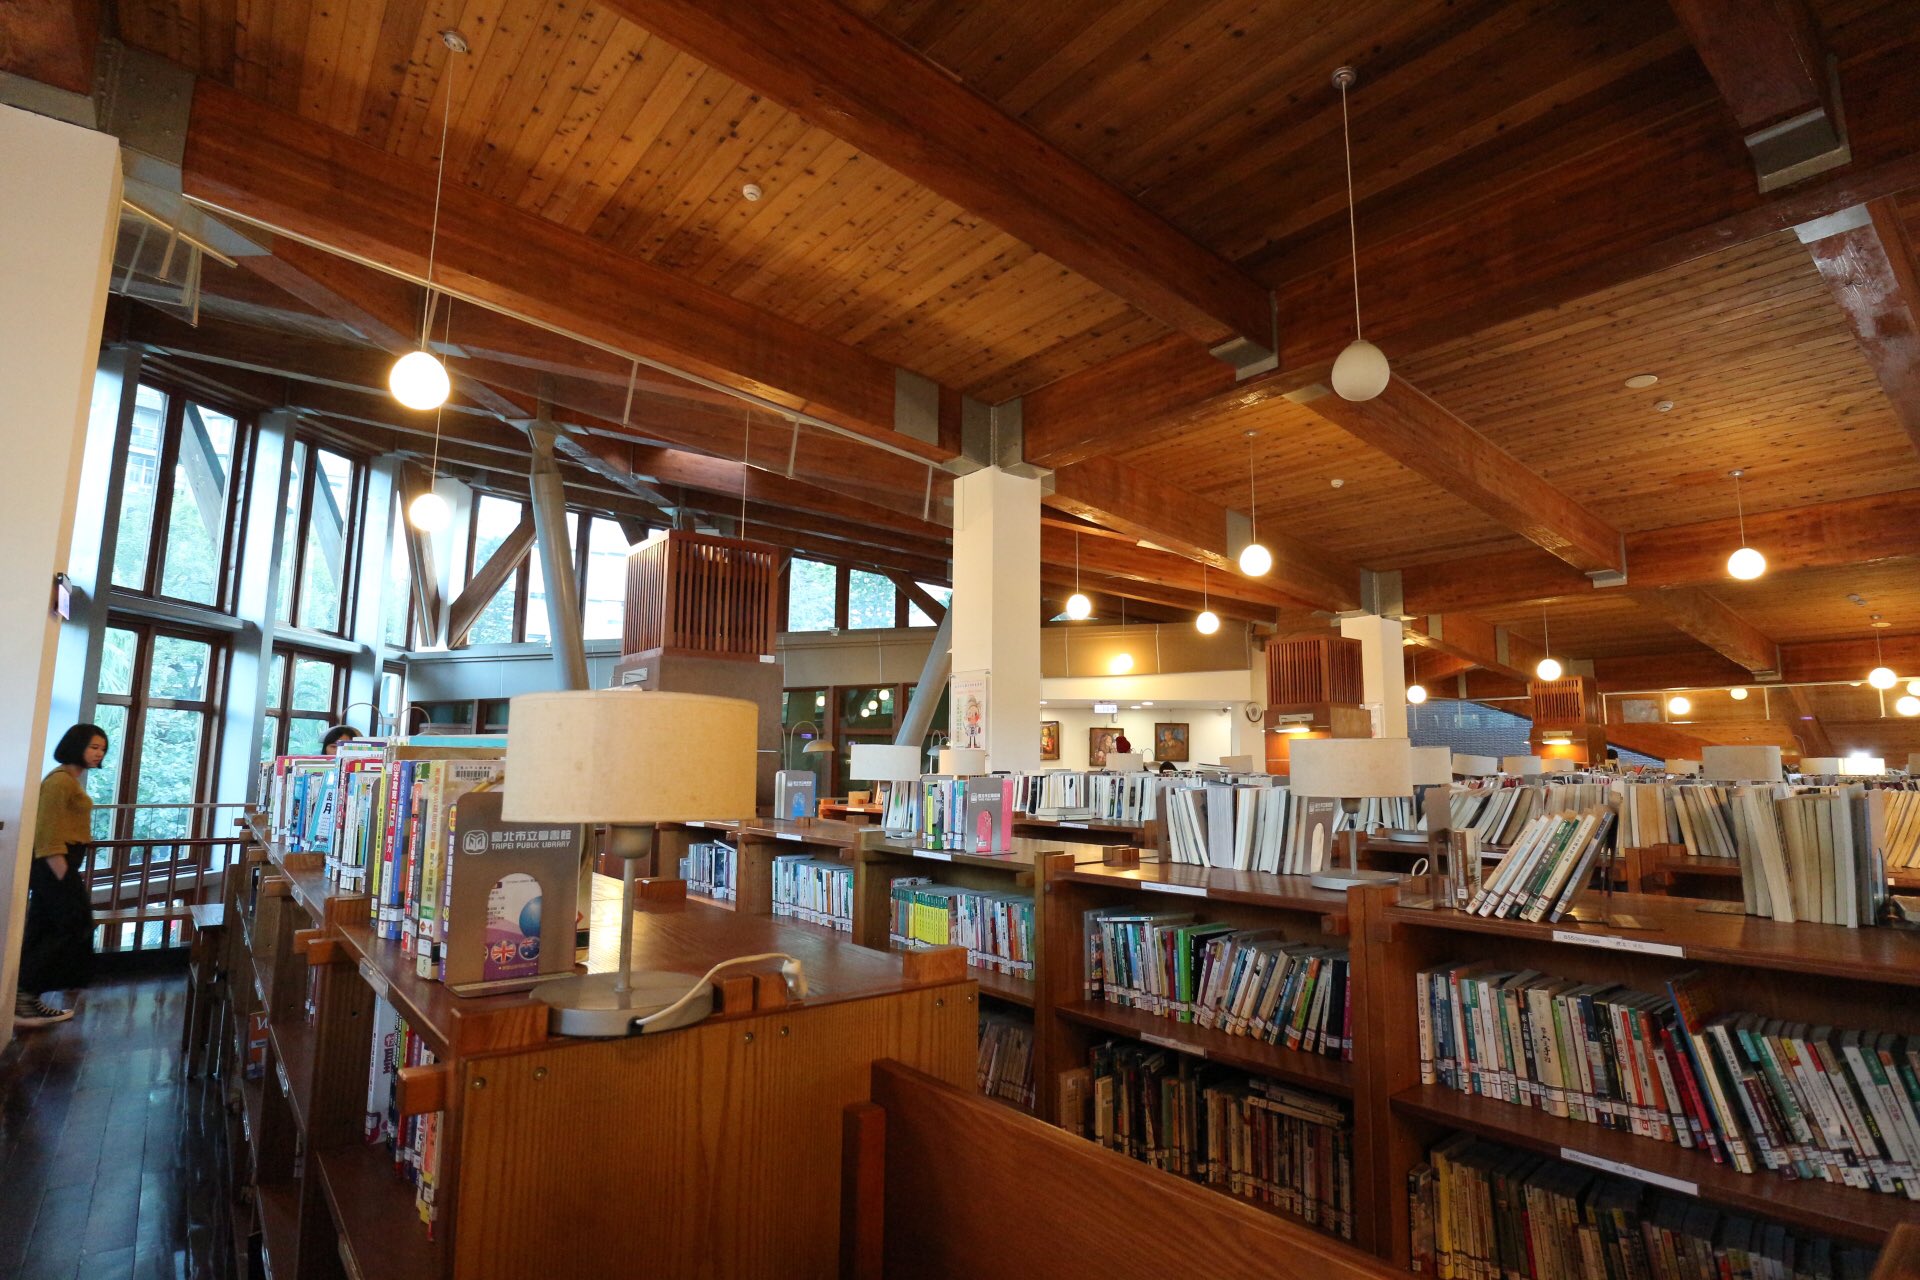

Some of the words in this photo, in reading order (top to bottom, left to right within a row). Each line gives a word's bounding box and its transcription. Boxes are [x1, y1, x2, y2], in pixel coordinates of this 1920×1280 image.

[491, 829, 572, 842] 臺北市立圖書館
[491, 842, 514, 850] TAIPEI
[516, 841, 540, 849] PUBLIC
[542, 840, 571, 848] LIBRARY
